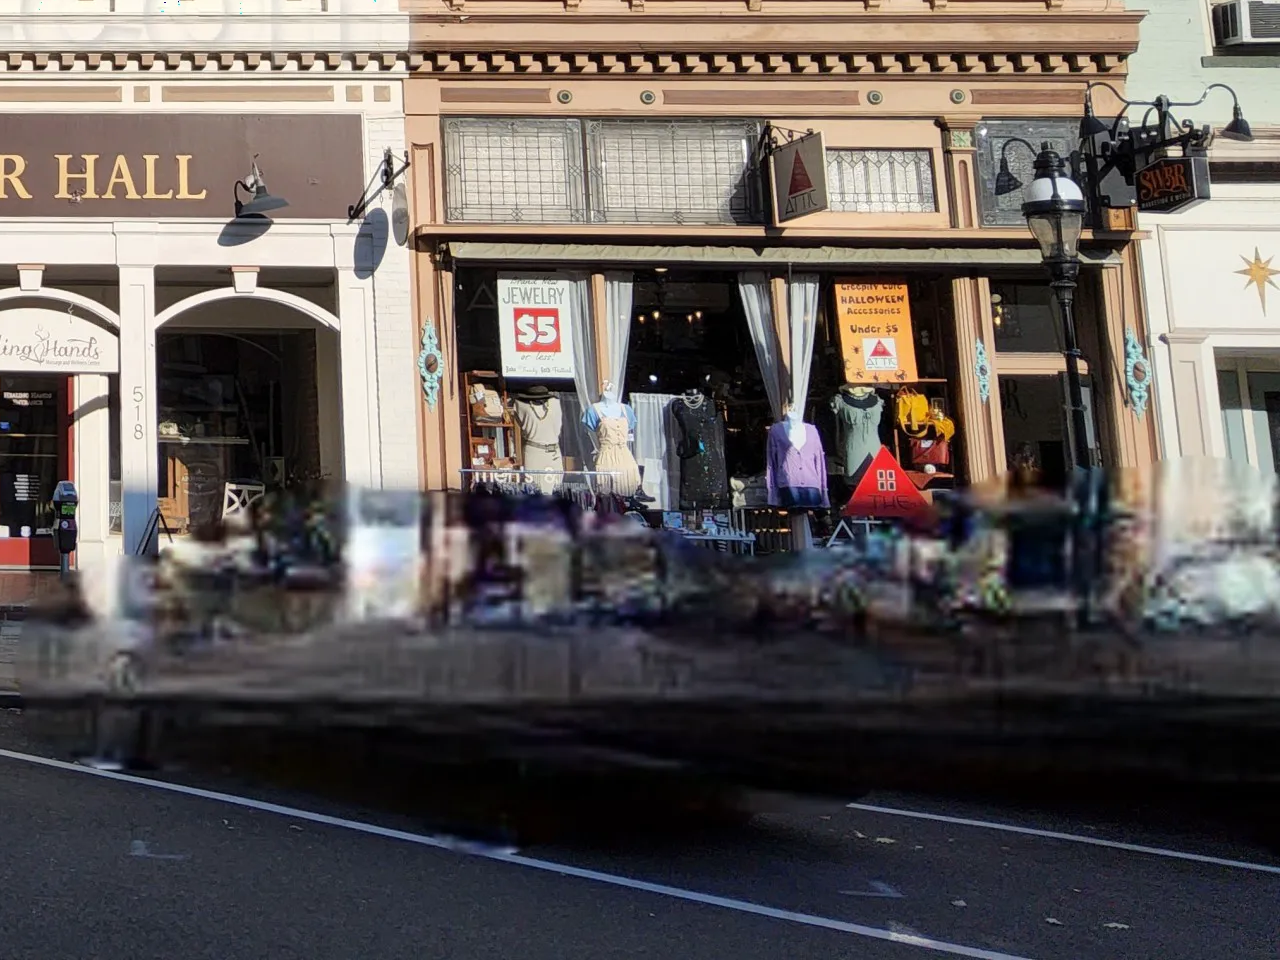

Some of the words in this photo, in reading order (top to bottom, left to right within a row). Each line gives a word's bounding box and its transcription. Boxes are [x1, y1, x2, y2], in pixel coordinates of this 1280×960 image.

[55, 153, 207, 201] HALL
[785, 189, 817, 215] ATTIC
[502, 286, 565, 305] JEWELRY
[840, 295, 905, 305] HALLOWEEN
[846, 307, 902, 315] Accessories
[516, 314, 557, 347] $5
[850, 324, 881, 334] Under
[885, 323, 899, 336] $5
[45, 337, 103, 360] Hands
[535, 351, 556, 361] less!
[132, 385, 144, 440] 518
[868, 494, 910, 511] THE
